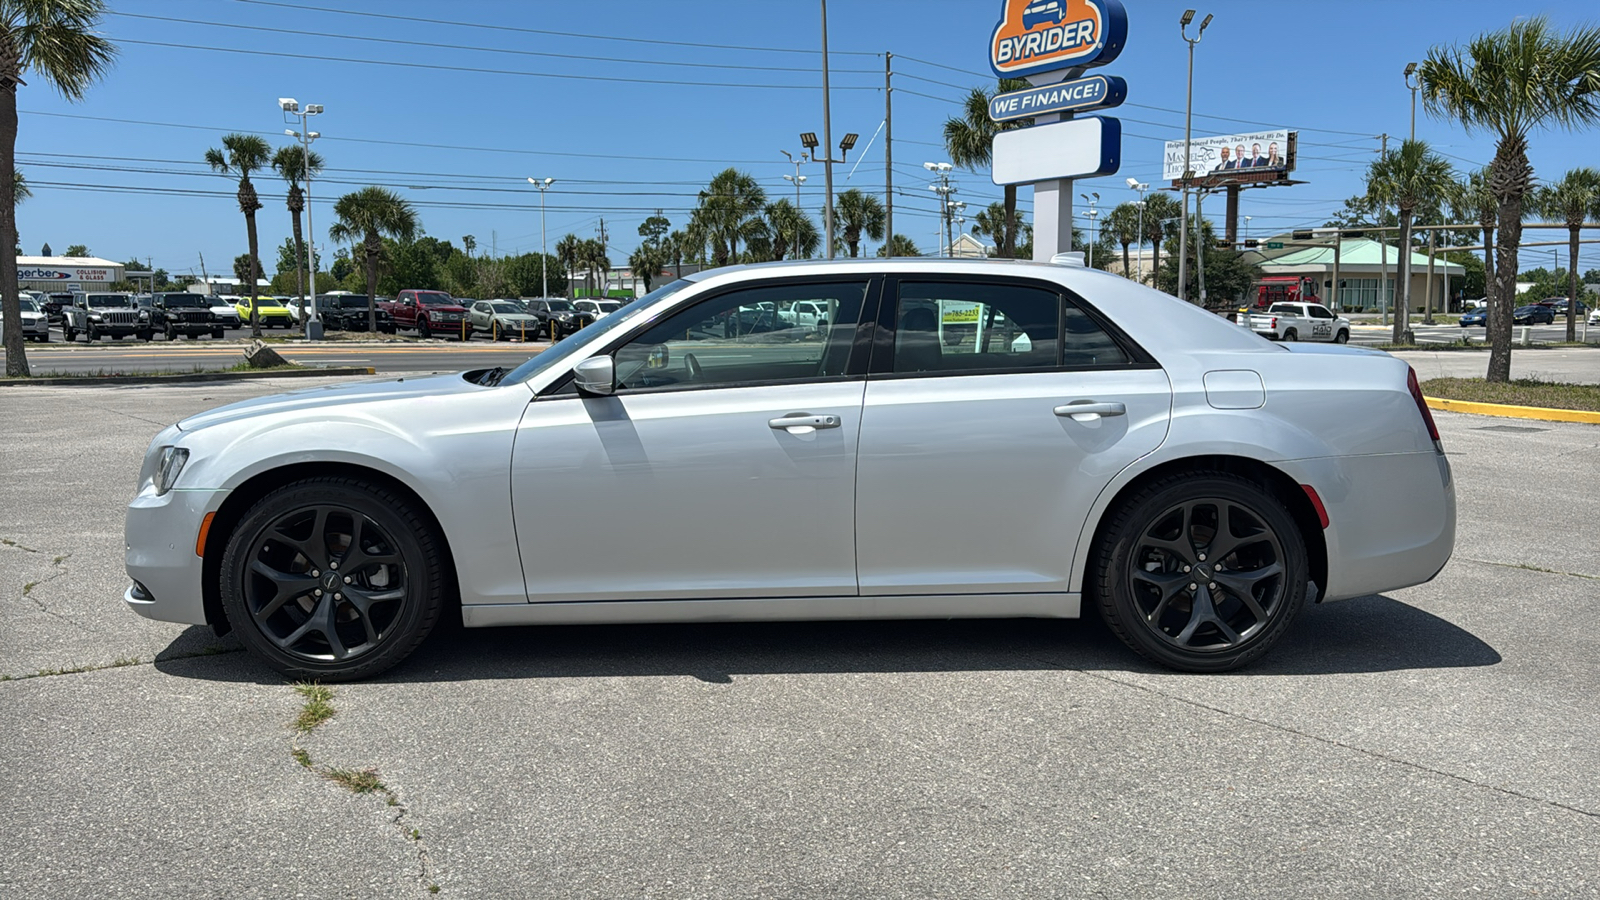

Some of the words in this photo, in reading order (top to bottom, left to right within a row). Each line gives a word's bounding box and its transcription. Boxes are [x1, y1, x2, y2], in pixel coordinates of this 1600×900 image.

[997, 20, 1094, 63] BYRIDER
[994, 98, 1019, 114] WE
[1021, 83, 1100, 109] FINANCE!
[17, 268, 58, 279] gerber
